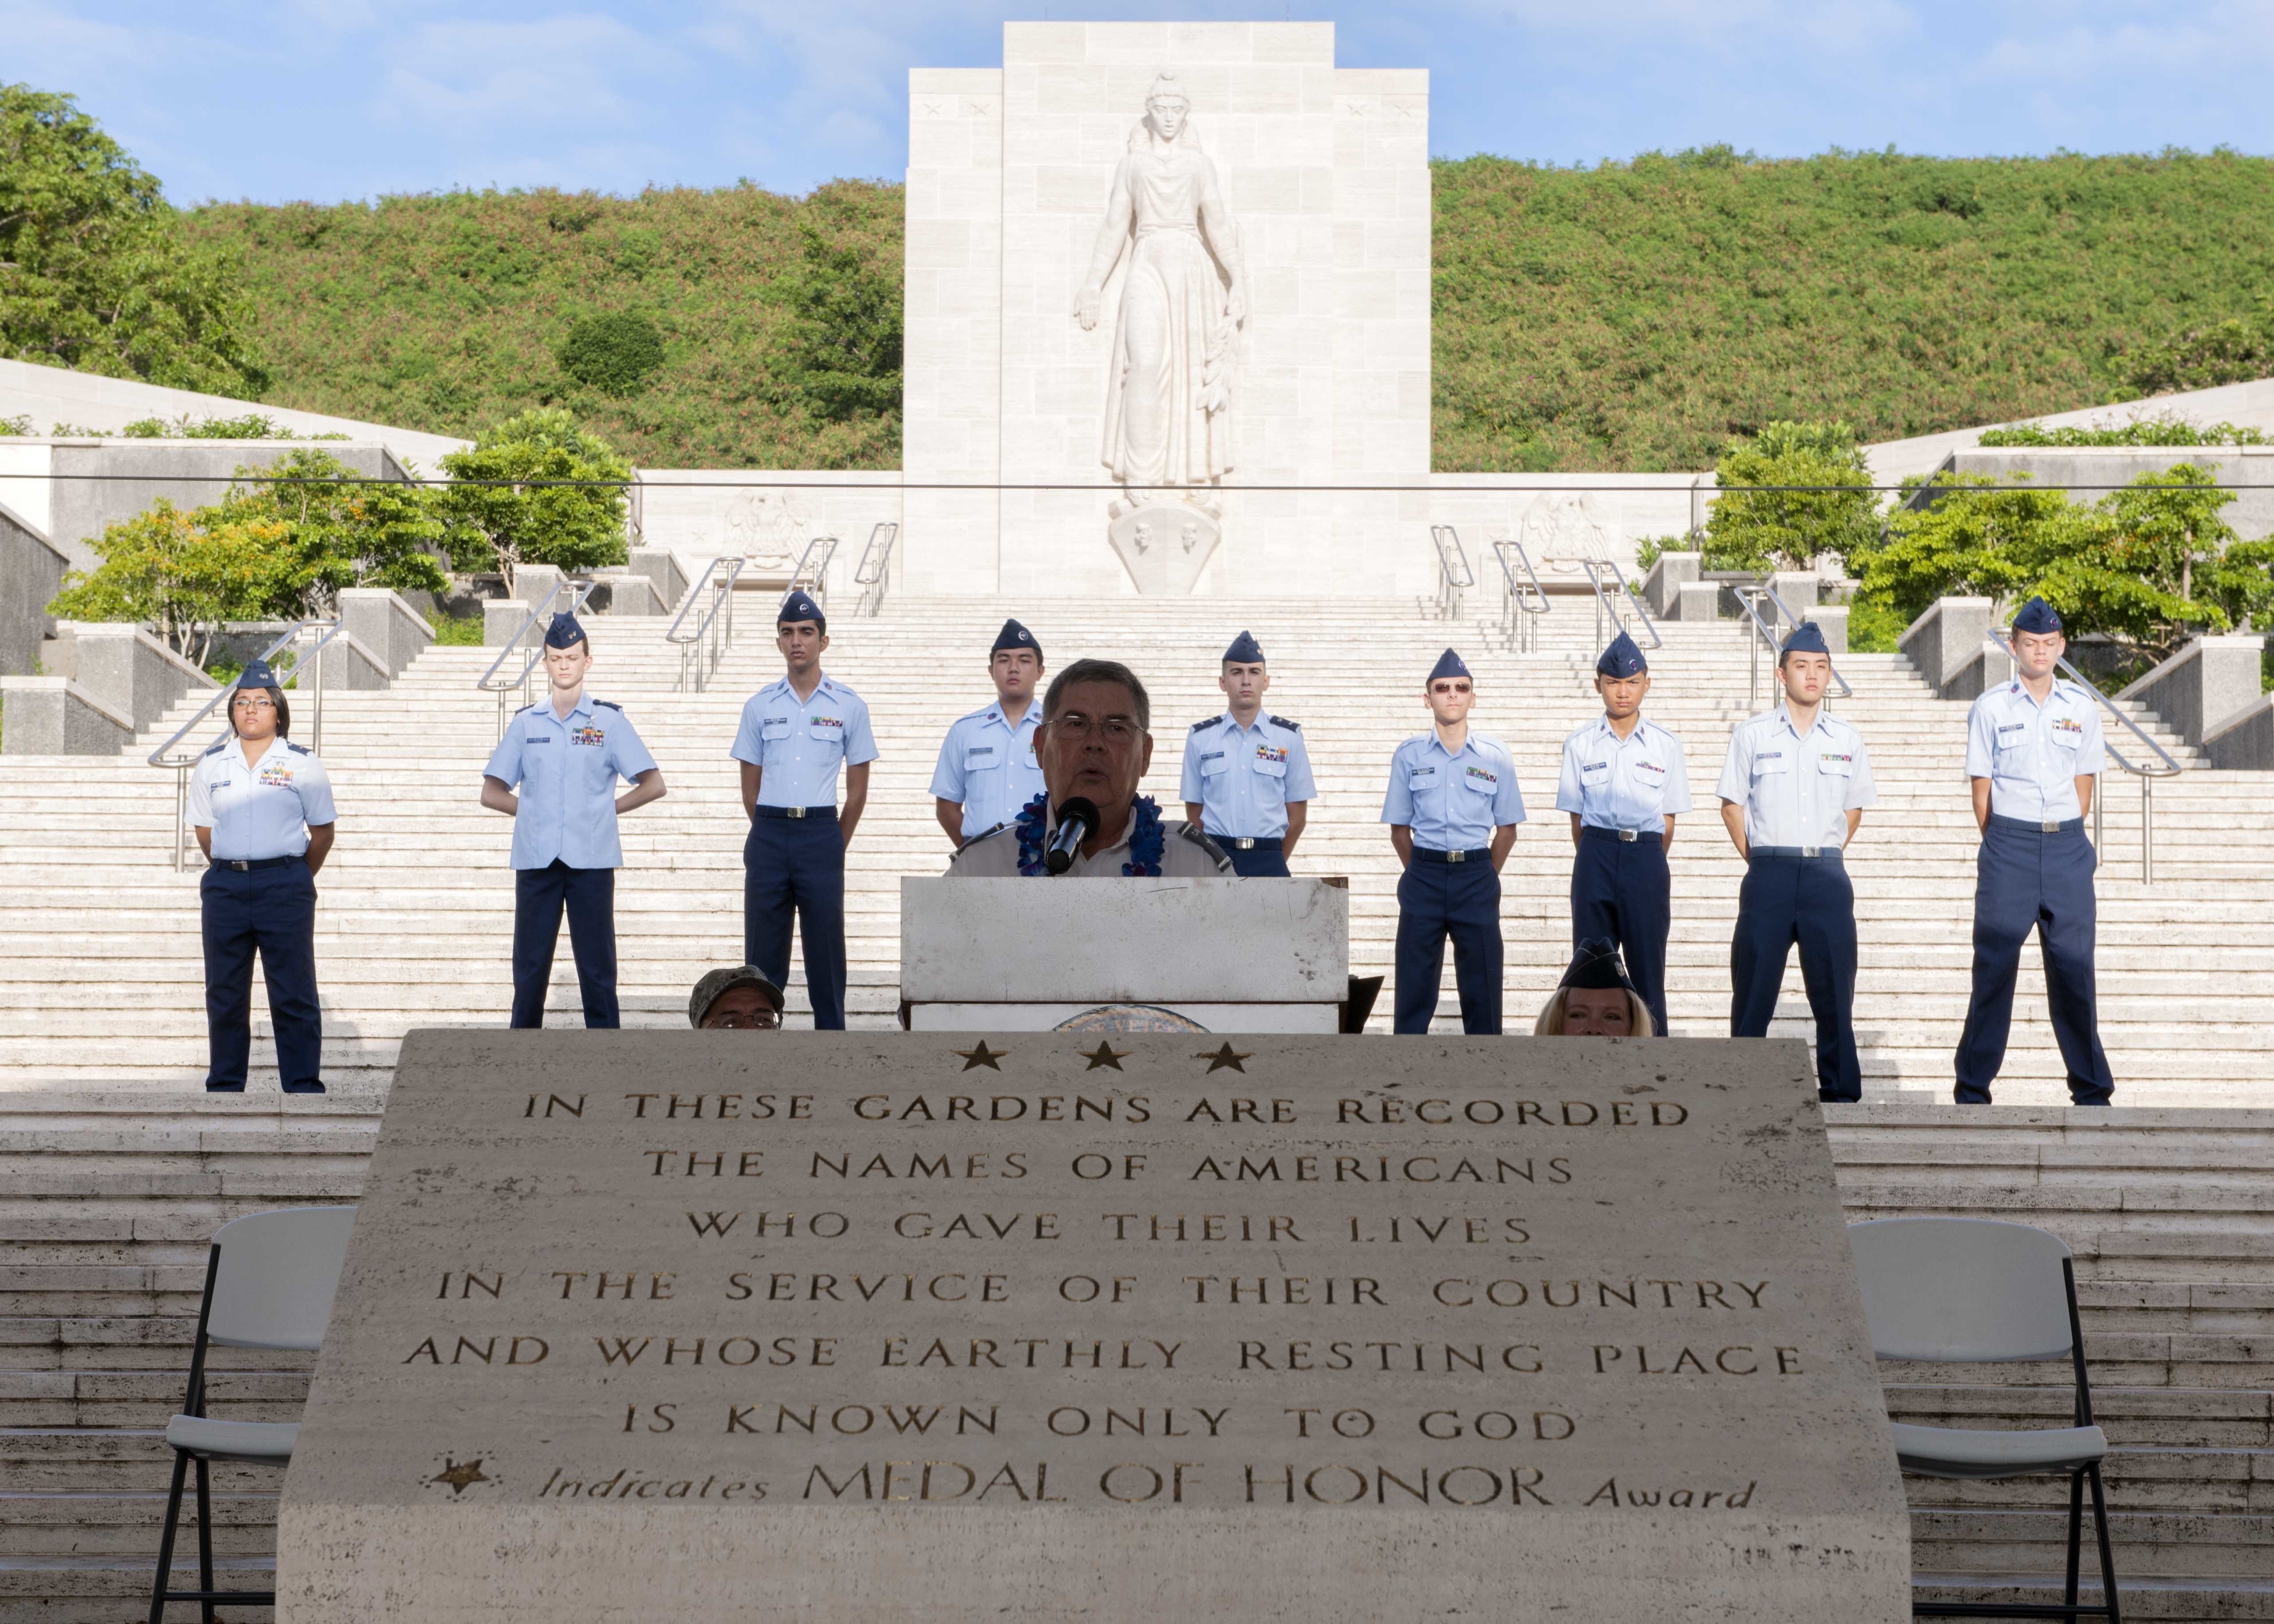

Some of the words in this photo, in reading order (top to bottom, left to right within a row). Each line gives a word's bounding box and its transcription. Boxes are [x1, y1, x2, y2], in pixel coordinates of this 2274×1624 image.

[524, 1093, 587, 1118] IN
[624, 1094, 814, 1119] THESE
[853, 1095, 1150, 1123] GARDENS
[1183, 1098, 1297, 1123] ARE
[1336, 1098, 1688, 1127] RECORDED
[643, 1150, 763, 1177] THE
[810, 1152, 1027, 1179] NAMES
[1072, 1154, 1147, 1180] OF
[1189, 1154, 1571, 1184] AMERICANS
[687, 1212, 849, 1238] WHO
[894, 1213, 1061, 1240] GAVE
[1102, 1214, 1304, 1241] THEIR
[1350, 1217, 1530, 1243] LIVES
[436, 1272, 505, 1299] IN
[552, 1272, 676, 1300] THE
[726, 1273, 1009, 1302] SERVICE
[1059, 1275, 1136, 1303] OF
[1187, 1276, 1388, 1305] THEIR
[1433, 1279, 1769, 1308] COUNTRY
[401, 1336, 549, 1365] AND
[598, 1337, 835, 1366] WHOSE
[880, 1338, 1181, 1369] EARTHLY
[1238, 1341, 1543, 1373] RESTING
[1593, 1346, 1803, 1375] PLACE
[622, 1404, 676, 1433] IS
[725, 1405, 998, 1435] KNOWN
[1048, 1407, 1231, 1436] ONLY
[1284, 1409, 1376, 1438] TO
[1419, 1410, 1575, 1440] GOD
[538, 1467, 767, 1503] Indicates
[802, 1461, 1067, 1502] MEDAL
[1100, 1463, 1205, 1503] OF
[1245, 1465, 1554, 1506] HONOR
[1583, 1477, 1757, 1509] Award
